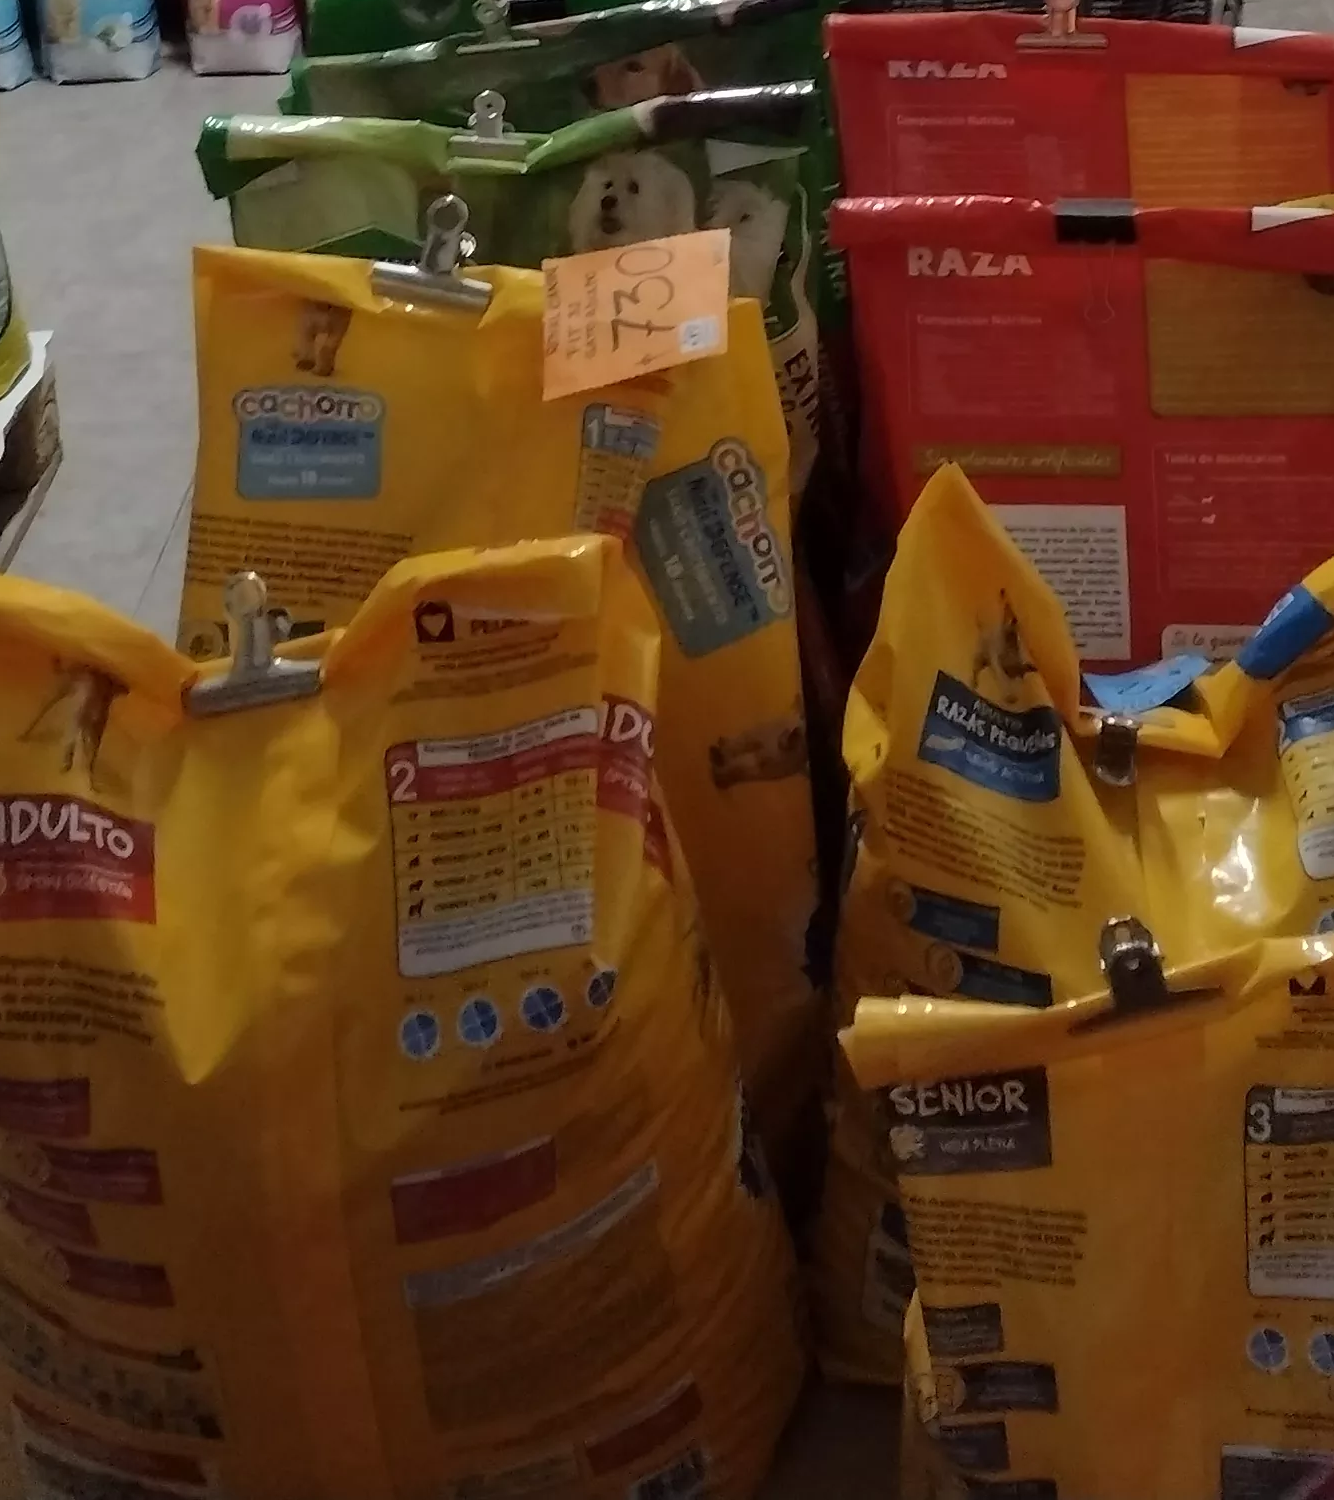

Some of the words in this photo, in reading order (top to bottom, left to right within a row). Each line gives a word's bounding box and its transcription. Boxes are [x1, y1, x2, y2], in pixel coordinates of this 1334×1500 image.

[908, 246, 1034, 278] RAZA
[611, 246, 675, 352] 730
[936, 694, 986, 738] RAZAS
[389, 759, 419, 802] 2
[888, 1078, 1030, 1117] SENIOR
[1247, 1101, 1272, 1142] 3
